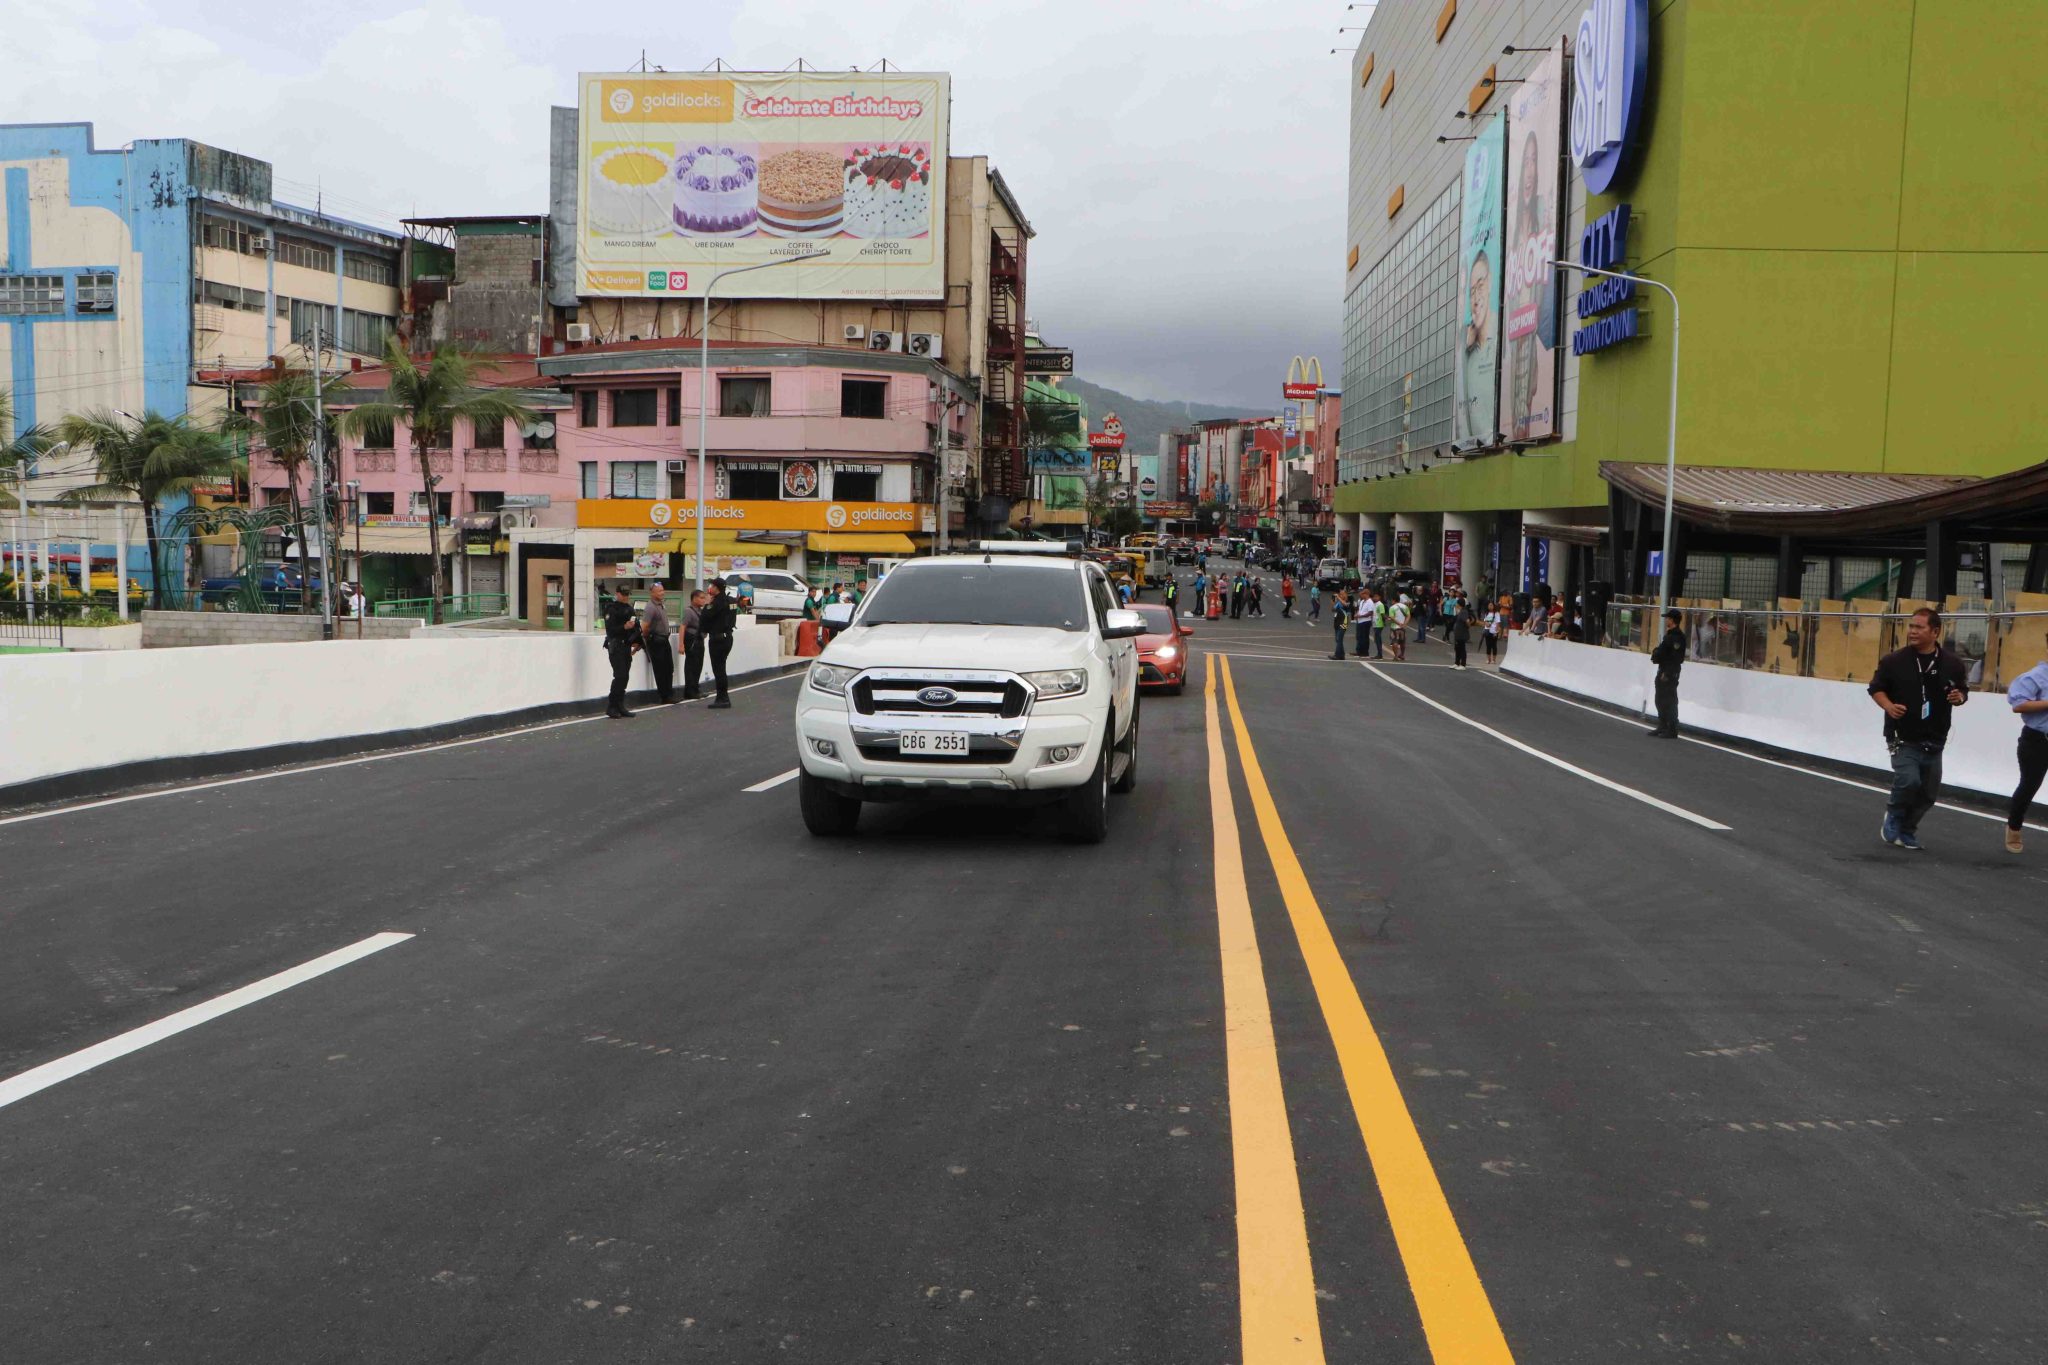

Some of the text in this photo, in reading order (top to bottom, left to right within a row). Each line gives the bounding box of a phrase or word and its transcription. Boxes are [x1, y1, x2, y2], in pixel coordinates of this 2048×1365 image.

[641, 92, 722, 113] goldilocks
[745, 97, 921, 119] Celebrate Birthdays
[604, 240, 657, 248] MANGO DREAM
[710, 241, 735, 249] DREAM
[1580, 204, 1626, 278] CITY
[769, 248, 801, 256] LAYERED
[859, 248, 912, 256] CHERRY TORTE
[1524, 229, 1554, 285] OFF
[1576, 272, 1629, 319] OLONGAPO
[1573, 311, 1632, 356] DOWNTOWN
[1090, 435, 1123, 445] Jollibee
[738, 462, 759, 471] TATTOO
[1101, 459, 1117, 470] 24
[851, 505, 913, 527] goldilocks
[880, 672, 998, 680] RANGER
[925, 690, 948, 701] Ford
[902, 735, 966, 750] CBG 2551
